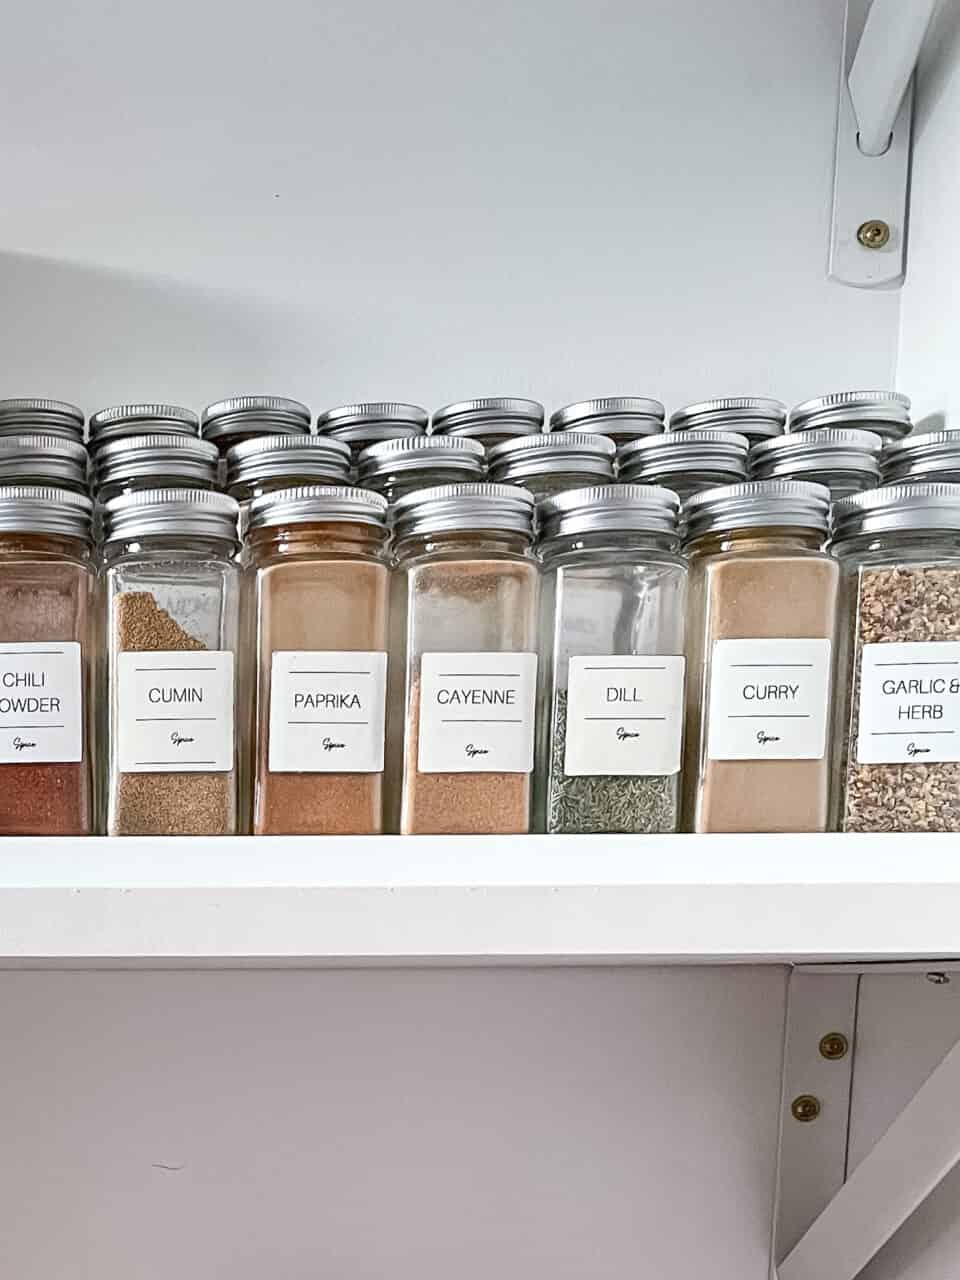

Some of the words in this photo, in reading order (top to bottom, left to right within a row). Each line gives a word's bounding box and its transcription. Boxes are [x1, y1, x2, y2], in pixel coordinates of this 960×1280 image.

[3, 672, 44, 687] CHILI
[883, 679, 945, 694] GARLIC
[949, 679, 960, 693] &
[149, 688, 202, 702] CUMIN
[437, 690, 515, 704] CAYENNE
[607, 687, 643, 702] DILL
[743, 685, 799, 699] CURRY
[295, 694, 360, 708] PAPRIKA
[899, 705, 943, 719] HERB
